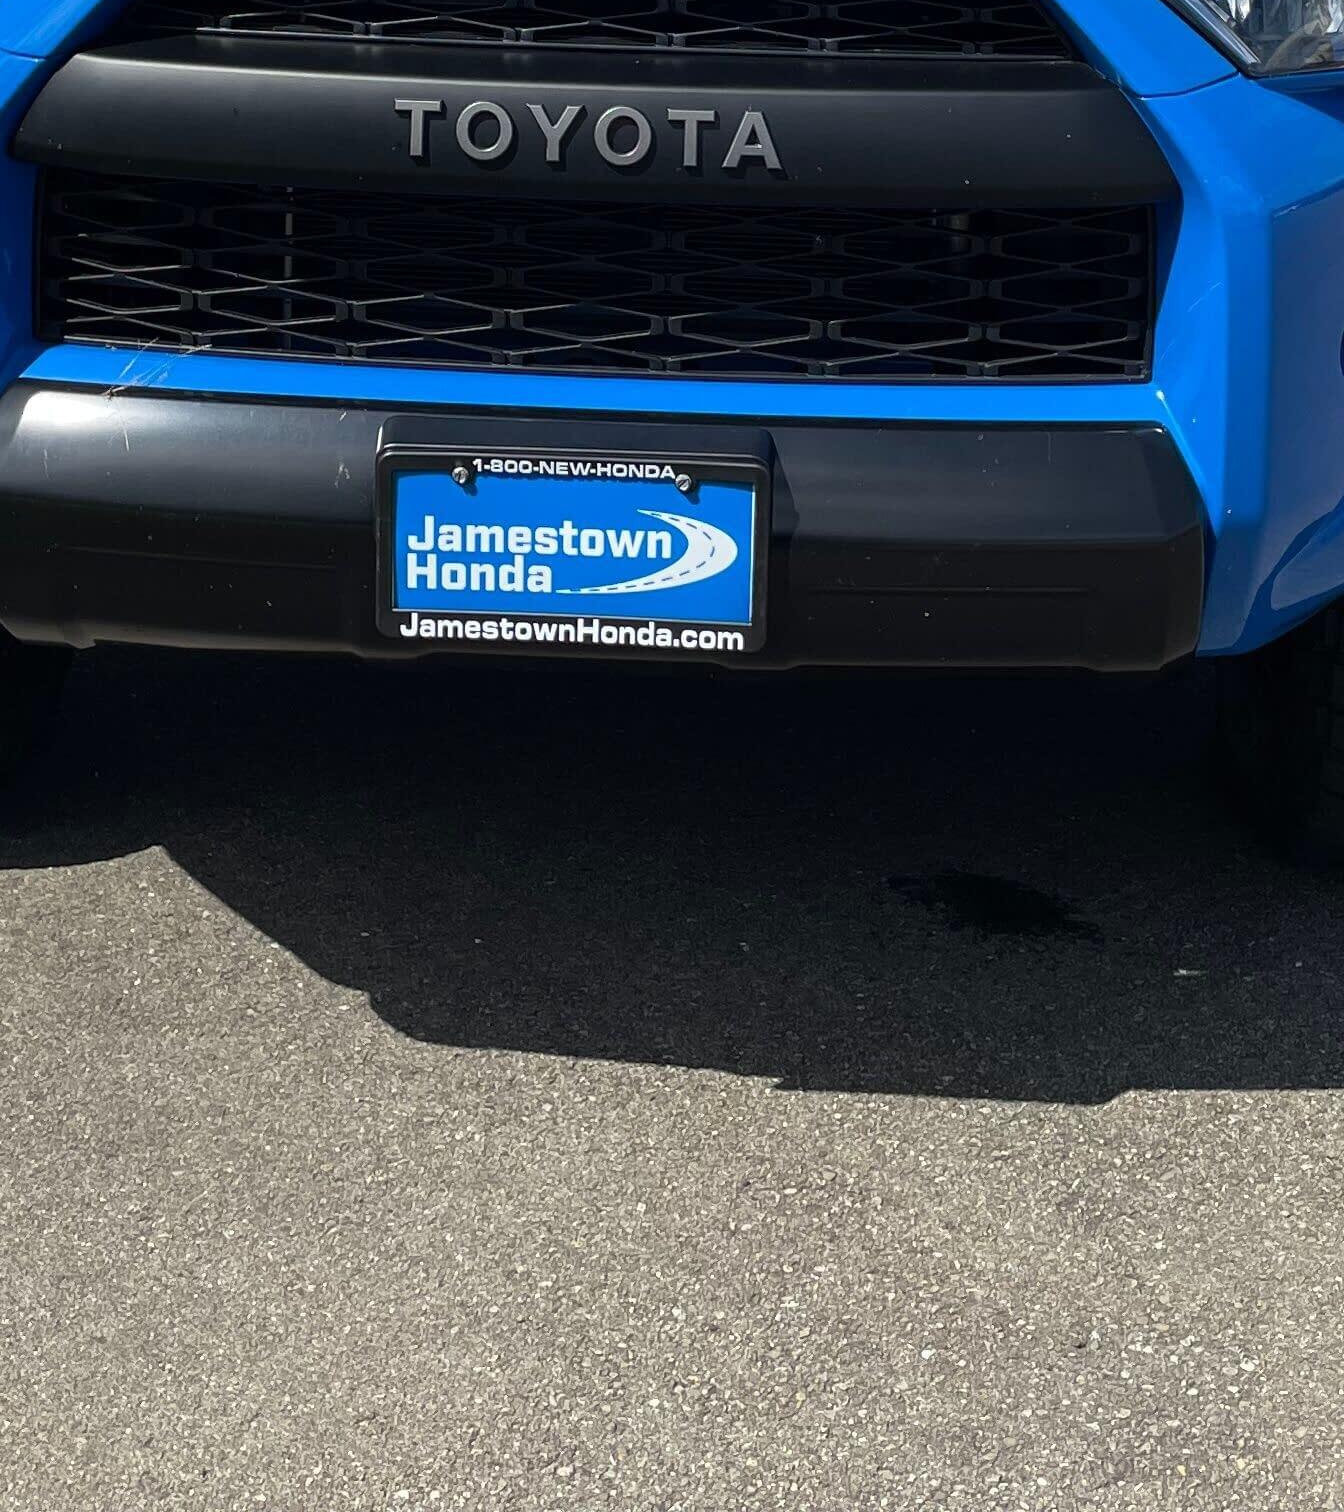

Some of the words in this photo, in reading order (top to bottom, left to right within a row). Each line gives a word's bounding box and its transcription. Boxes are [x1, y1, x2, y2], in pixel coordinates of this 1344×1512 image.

[394, 98, 784, 171] TOYOTA
[472, 458, 676, 480] 1-800-NEW-HONDA
[407, 515, 674, 559] Jamestown
[406, 553, 553, 594] Honda
[399, 612, 745, 651] JamestownHonda.com
